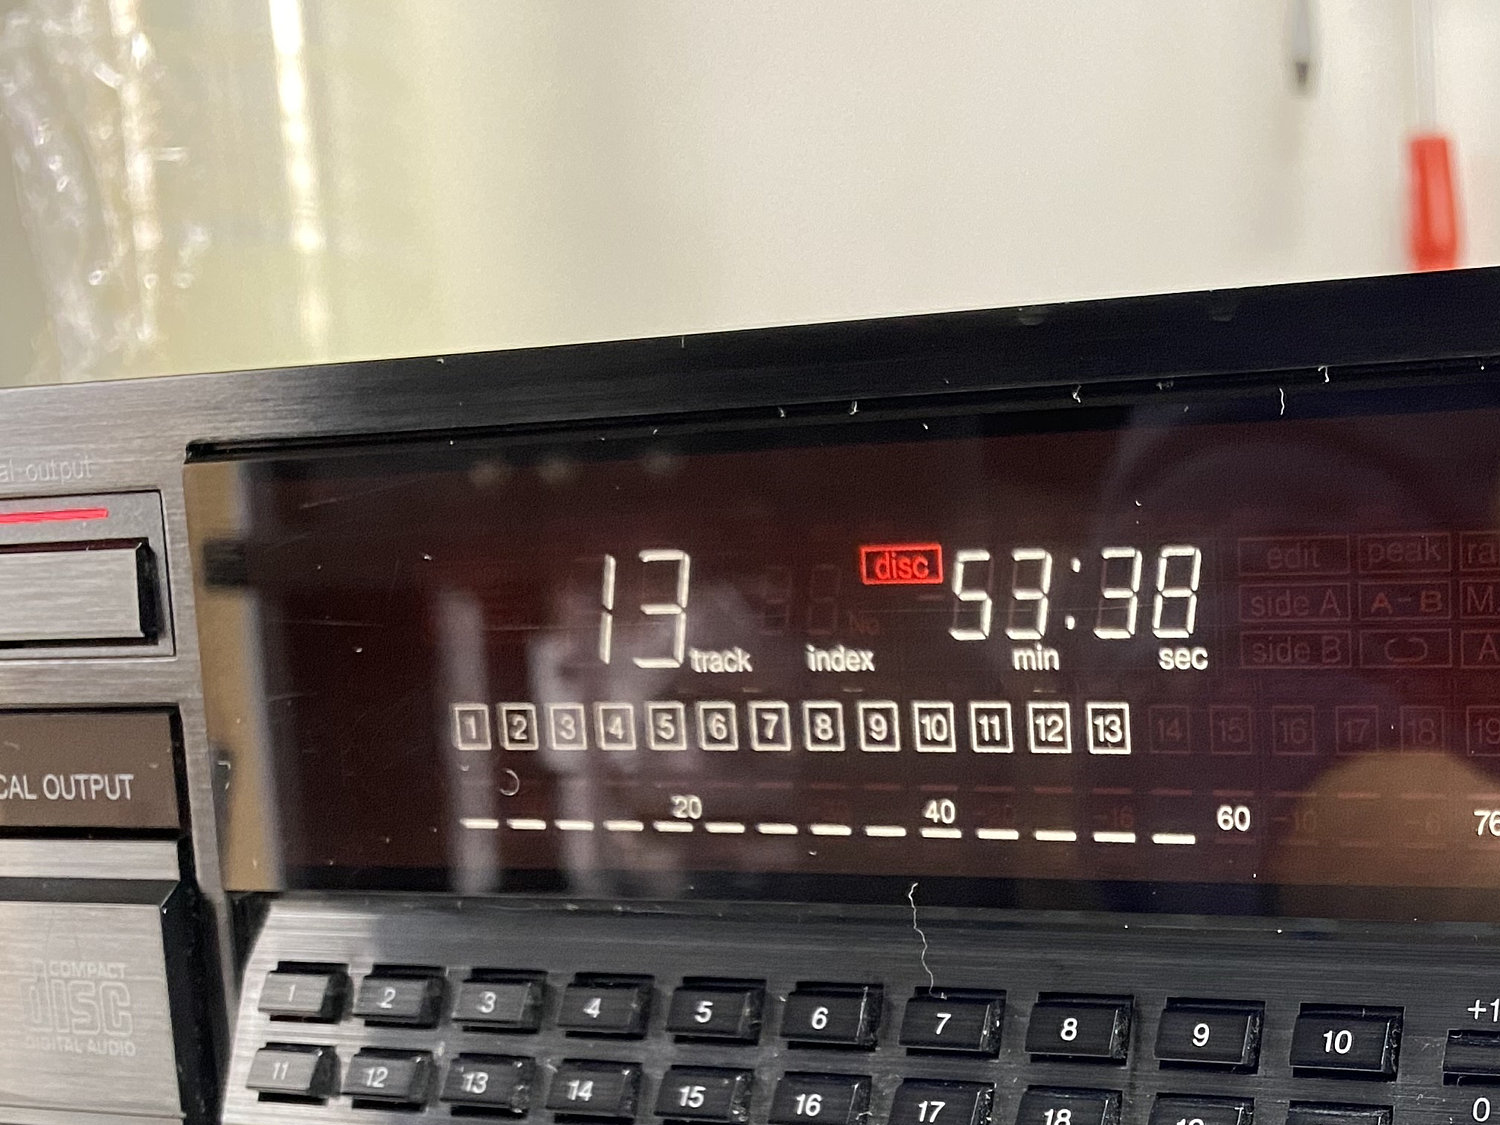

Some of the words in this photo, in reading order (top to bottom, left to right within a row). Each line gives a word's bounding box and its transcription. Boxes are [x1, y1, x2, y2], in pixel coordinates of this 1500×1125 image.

[25, 455, 94, 485] output
[1266, 543, 1320, 570] edit
[1367, 535, 1442, 566] peak
[874, 552, 930, 580] disc
[949, 545, 1202, 640] 53:38
[1251, 588, 1309, 617] side
[1319, 588, 1341, 616] A
[601, 549, 690, 668] 13
[691, 646, 752, 673] track
[806, 644, 875, 672] index
[1012, 643, 1060, 671] min
[1158, 648, 1208, 670] sec
[1252, 636, 1310, 664] side
[1321, 636, 1341, 662] B
[465, 715, 477, 740] 1
[511, 714, 528, 740] 2
[559, 714, 577, 740] 3
[608, 714, 624, 740] 4
[656, 714, 675, 740] 5
[708, 713, 727, 740] 6
[761, 713, 779, 740] 7
[814, 713, 832, 740] 8
[869, 713, 888, 740] 9
[920, 713, 948, 741] 10
[977, 713, 1001, 741] 11
[1034, 714, 1063, 742] 12
[1093, 714, 1123, 743] 13
[1156, 718, 1182, 742] 14
[1217, 718, 1245, 743] 15
[1279, 718, 1308, 744] 16
[1343, 718, 1369, 743] 17
[1408, 718, 1436, 744] 18
[43, 773, 134, 800] OUTPUT
[670, 795, 701, 820] 20
[924, 799, 956, 824] 40
[1216, 805, 1251, 832] 60
[50, 961, 127, 980] COMPACT
[288, 985, 297, 1003] 1
[380, 988, 397, 1010] 2
[481, 991, 496, 1014] 3
[584, 997, 602, 1018] 4
[695, 1000, 714, 1024] 5
[811, 1007, 829, 1030] 6
[936, 1013, 952, 1035] 7
[1061, 1017, 1078, 1042] 8
[1192, 1022, 1210, 1047] 9
[87, 1038, 137, 1057] AUDIO
[1322, 1029, 1352, 1055] 10
[272, 1061, 289, 1081] 11
[366, 1066, 388, 1088] 12
[463, 1071, 489, 1095] 13
[567, 1079, 594, 1102] 14
[679, 1085, 705, 1109] 15
[796, 1094, 821, 1118] 16
[918, 1100, 945, 1123] 17
[1472, 1097, 1491, 1122] 0
